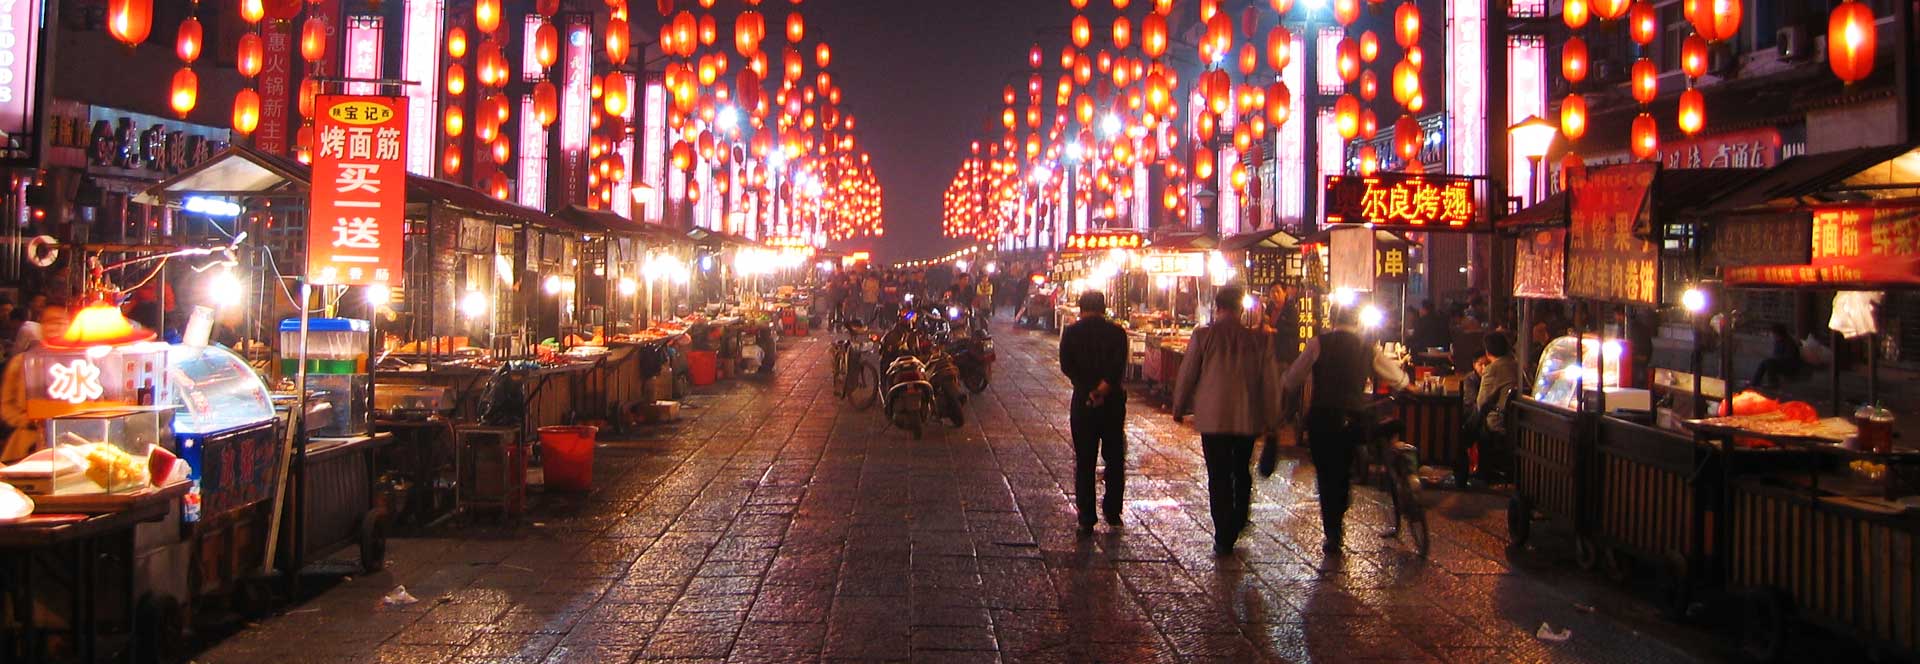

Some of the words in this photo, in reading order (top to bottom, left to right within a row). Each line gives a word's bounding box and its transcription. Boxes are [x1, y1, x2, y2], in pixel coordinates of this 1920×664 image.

[319, 125, 401, 161] 烤面筋
[331, 163, 382, 263] 买一送一
[1571, 211, 1650, 252] 煎饼果
[47, 359, 104, 403] 冰
